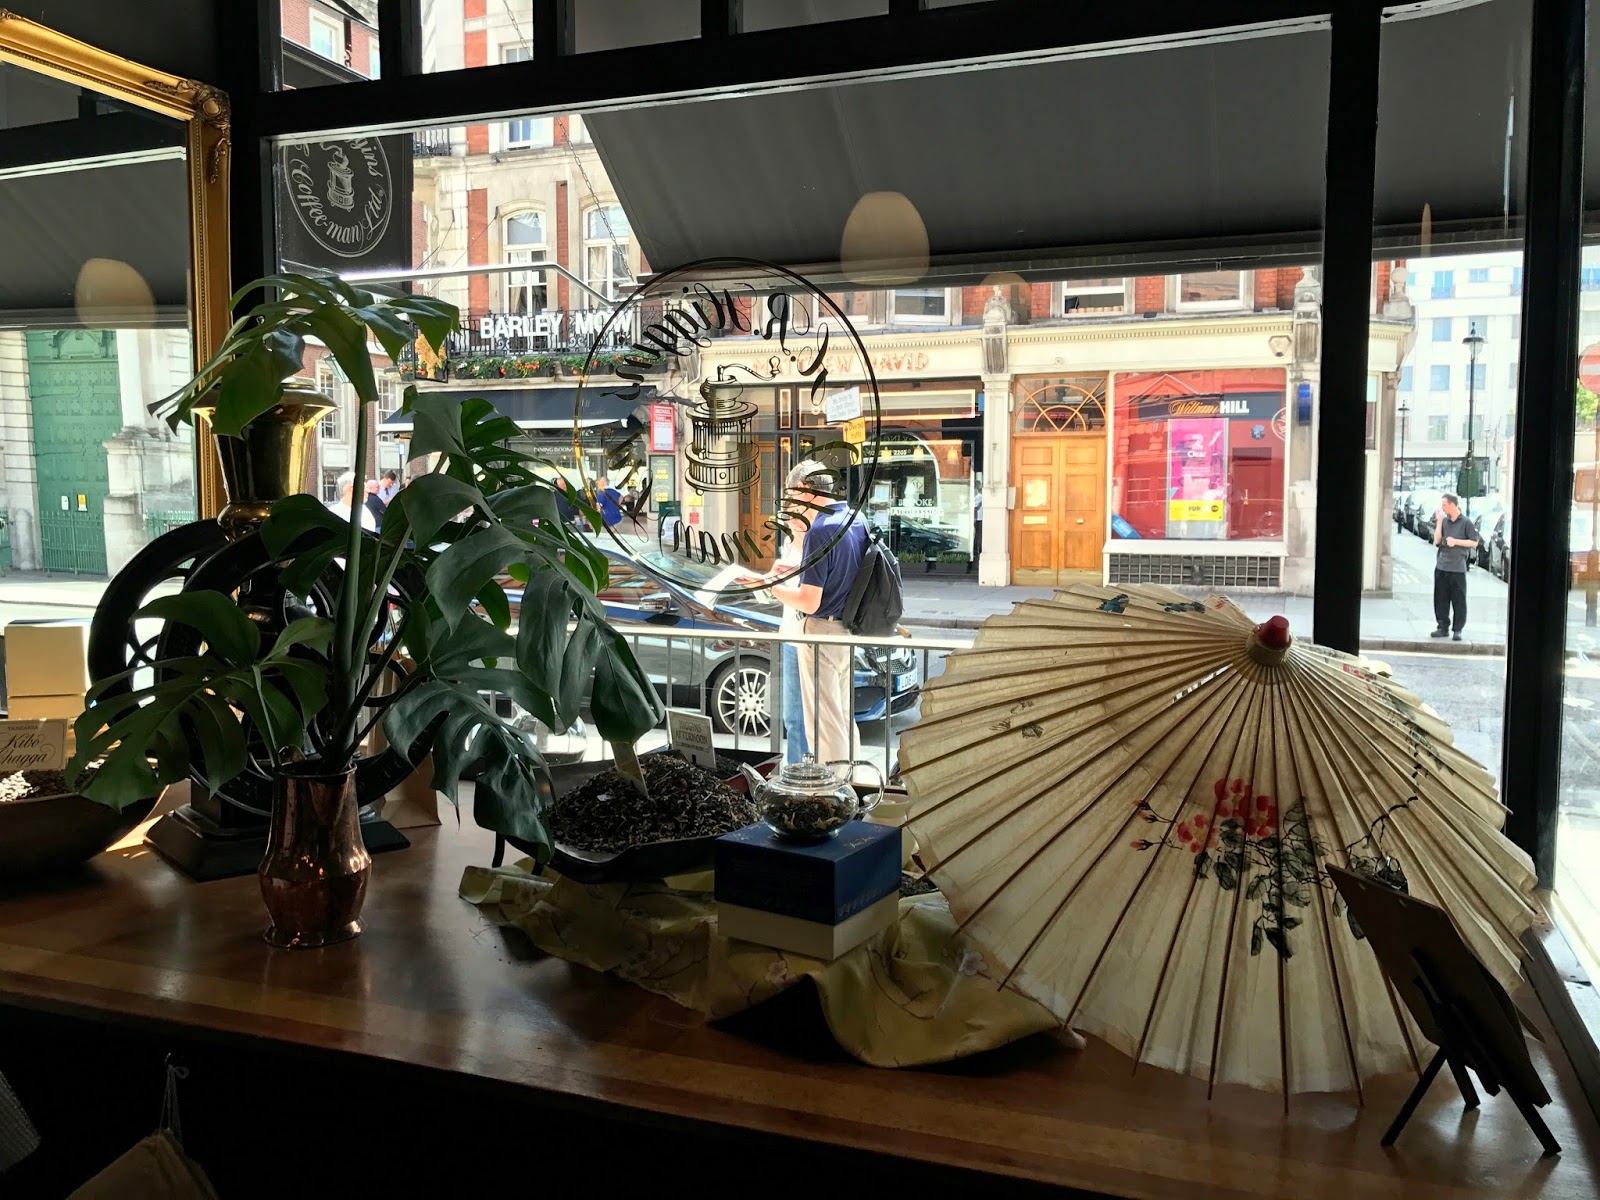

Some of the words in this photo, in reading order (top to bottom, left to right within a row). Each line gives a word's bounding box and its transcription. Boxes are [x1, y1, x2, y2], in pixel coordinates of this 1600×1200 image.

[480, 313, 564, 339] BARLEY
[575, 310, 634, 335] MOW
[752, 355, 853, 376] MTTEW
[1168, 400, 1220, 416] William
[1220, 400, 1250, 414] HILL
[1187, 450, 1207, 458] Clear
[898, 498, 932, 507] BOKE
[0, 731, 46, 751] Kibo
